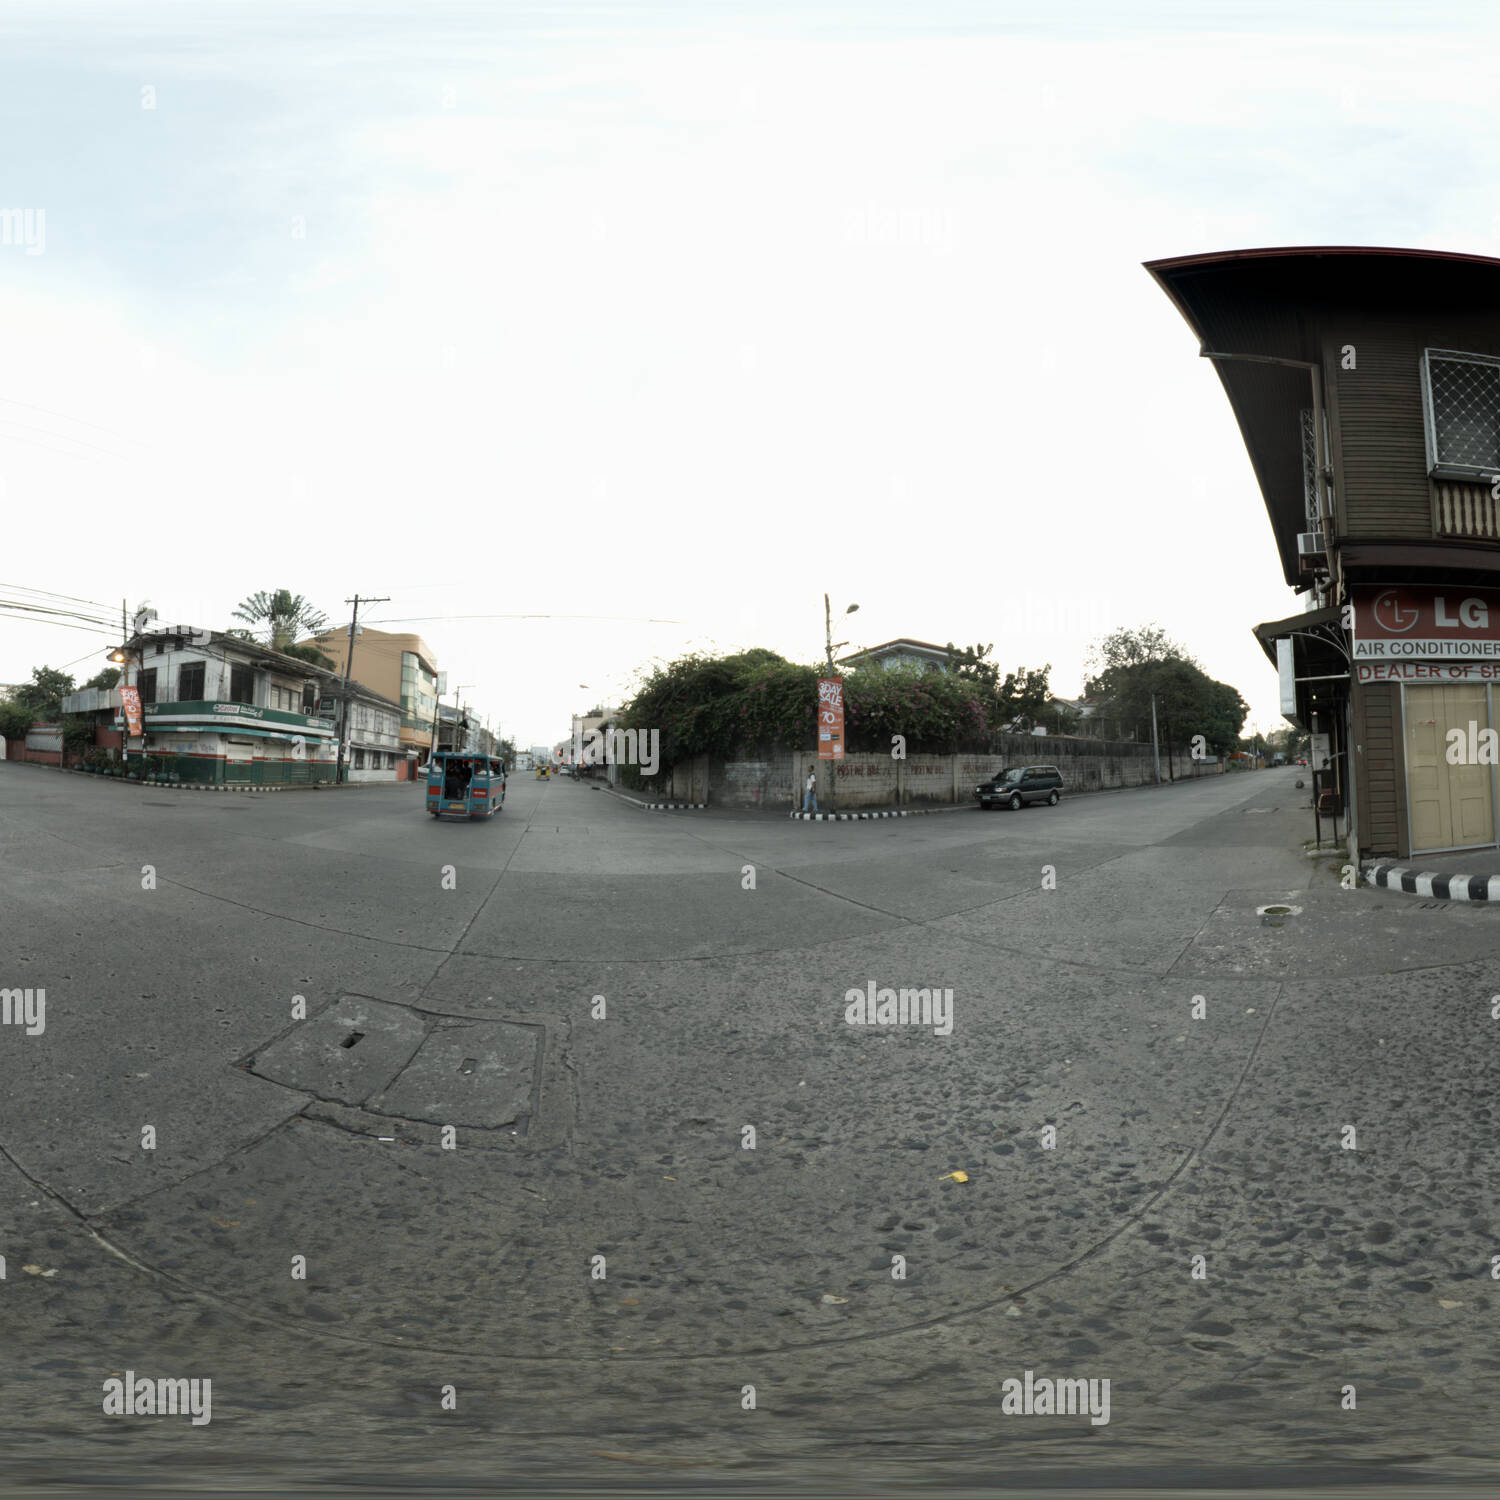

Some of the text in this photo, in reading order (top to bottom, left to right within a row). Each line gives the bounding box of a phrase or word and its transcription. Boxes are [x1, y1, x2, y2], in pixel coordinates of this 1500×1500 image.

[1435, 597, 1489, 629] LG
[1356, 642, 1384, 655] AIR
[1359, 664, 1442, 681] DEALER
[1449, 666, 1470, 679] OF
[821, 711, 835, 724] 70
